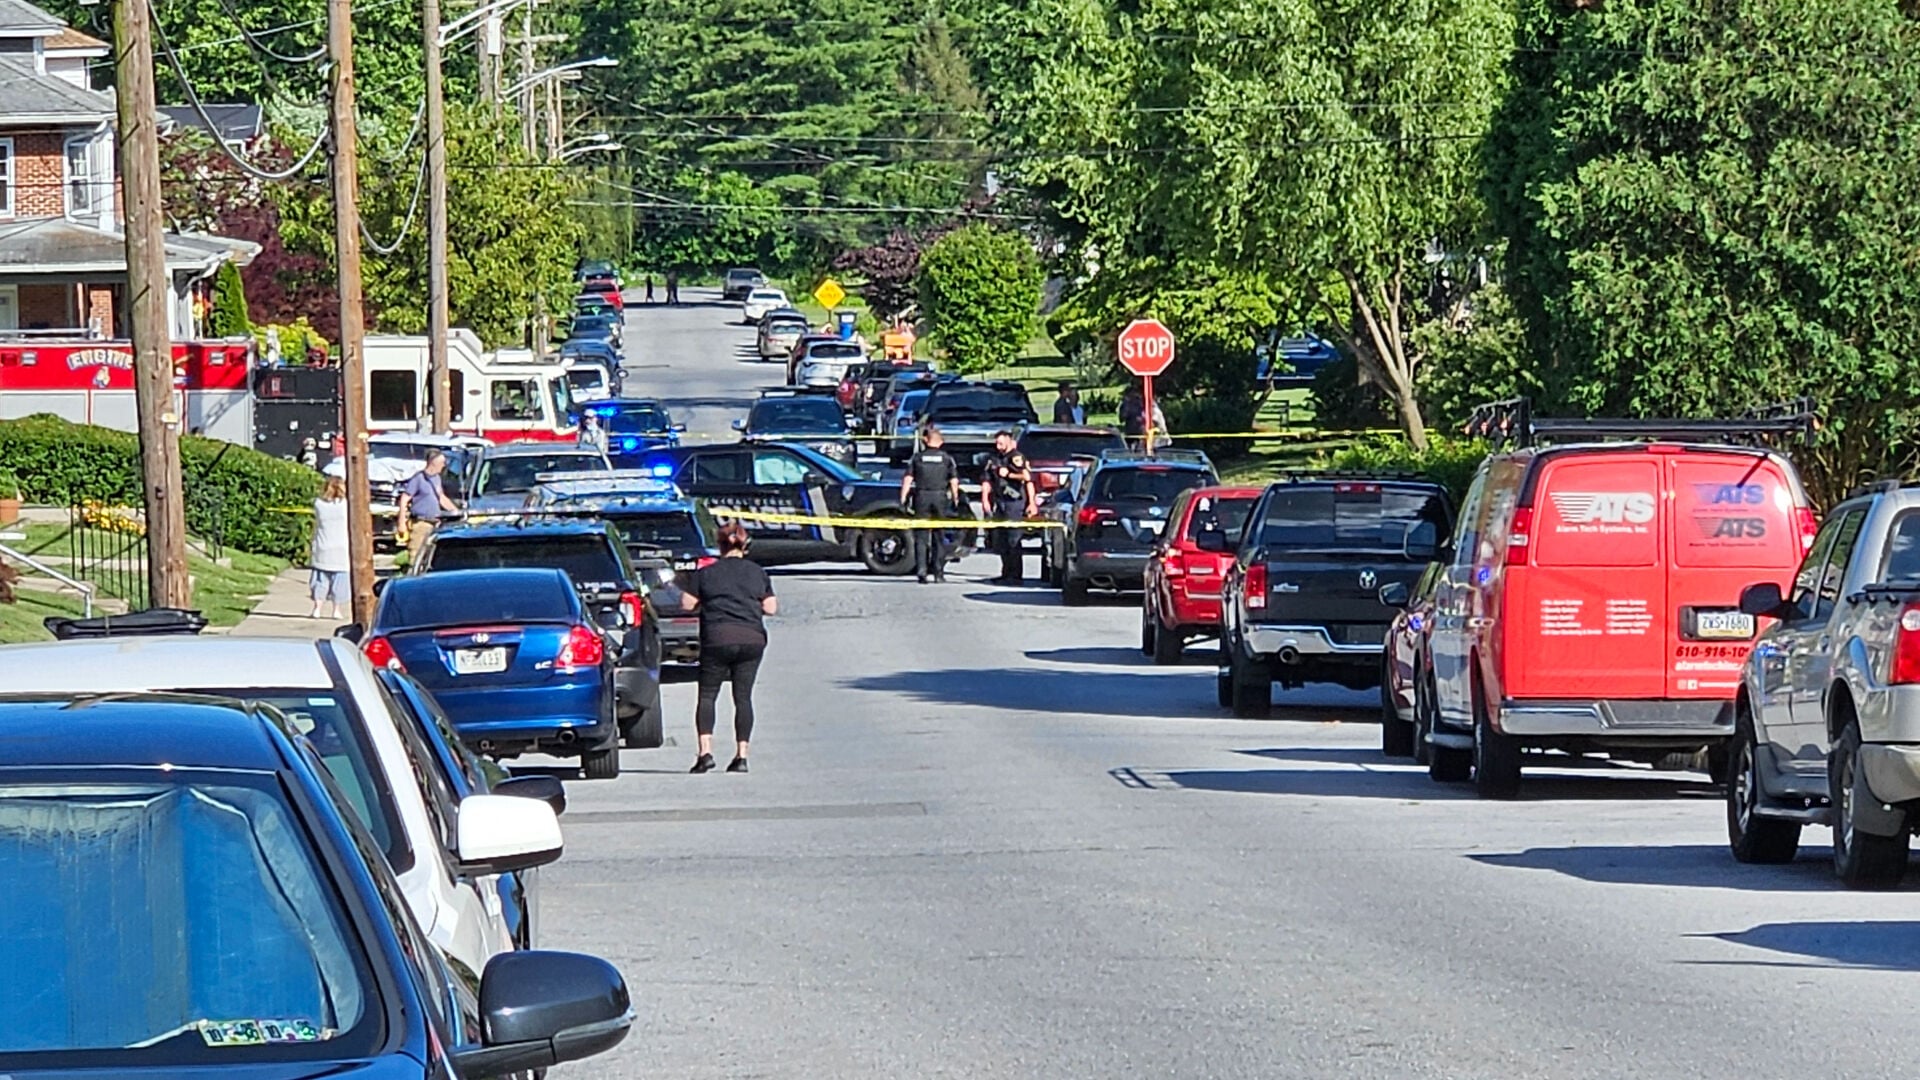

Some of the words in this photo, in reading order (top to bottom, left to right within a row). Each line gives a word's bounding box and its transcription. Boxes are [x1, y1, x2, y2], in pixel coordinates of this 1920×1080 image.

[1123, 337, 1170, 359] STOP
[1711, 484, 1764, 504] ATS
[1582, 492, 1655, 525] ATS
[1712, 517, 1766, 538] ATS
